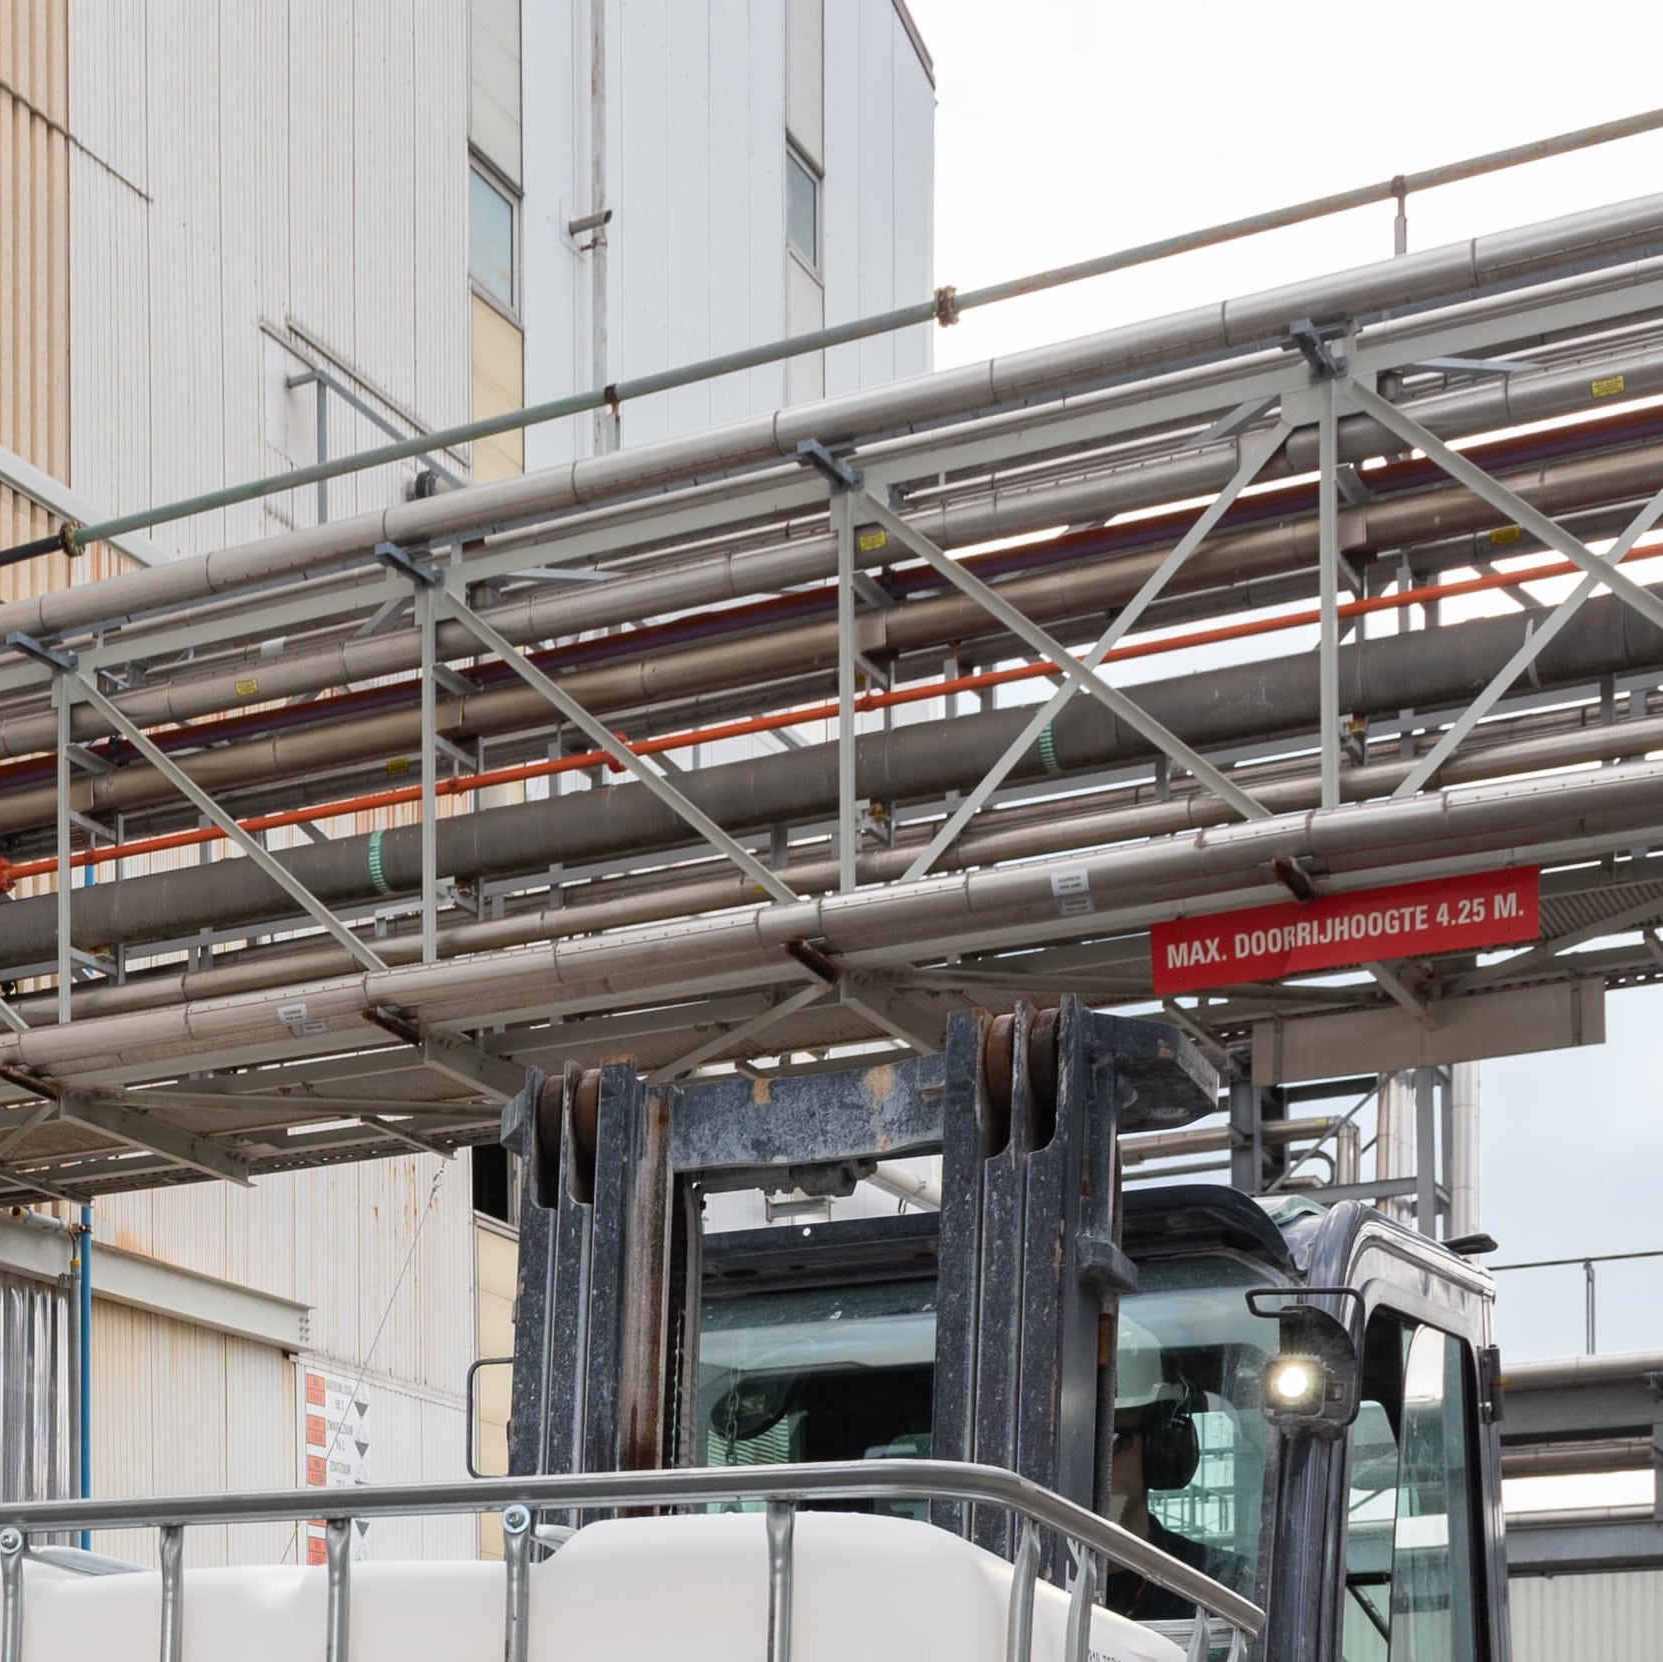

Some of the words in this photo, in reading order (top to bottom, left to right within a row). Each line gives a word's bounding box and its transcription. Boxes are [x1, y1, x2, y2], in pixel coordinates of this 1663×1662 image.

[1167, 937, 1227, 969] MAX.
[1234, 905, 1429, 959] DOORRIJHOOGTE
[1435, 898, 1486, 926] 4.25
[1493, 892, 1525, 920] M.
